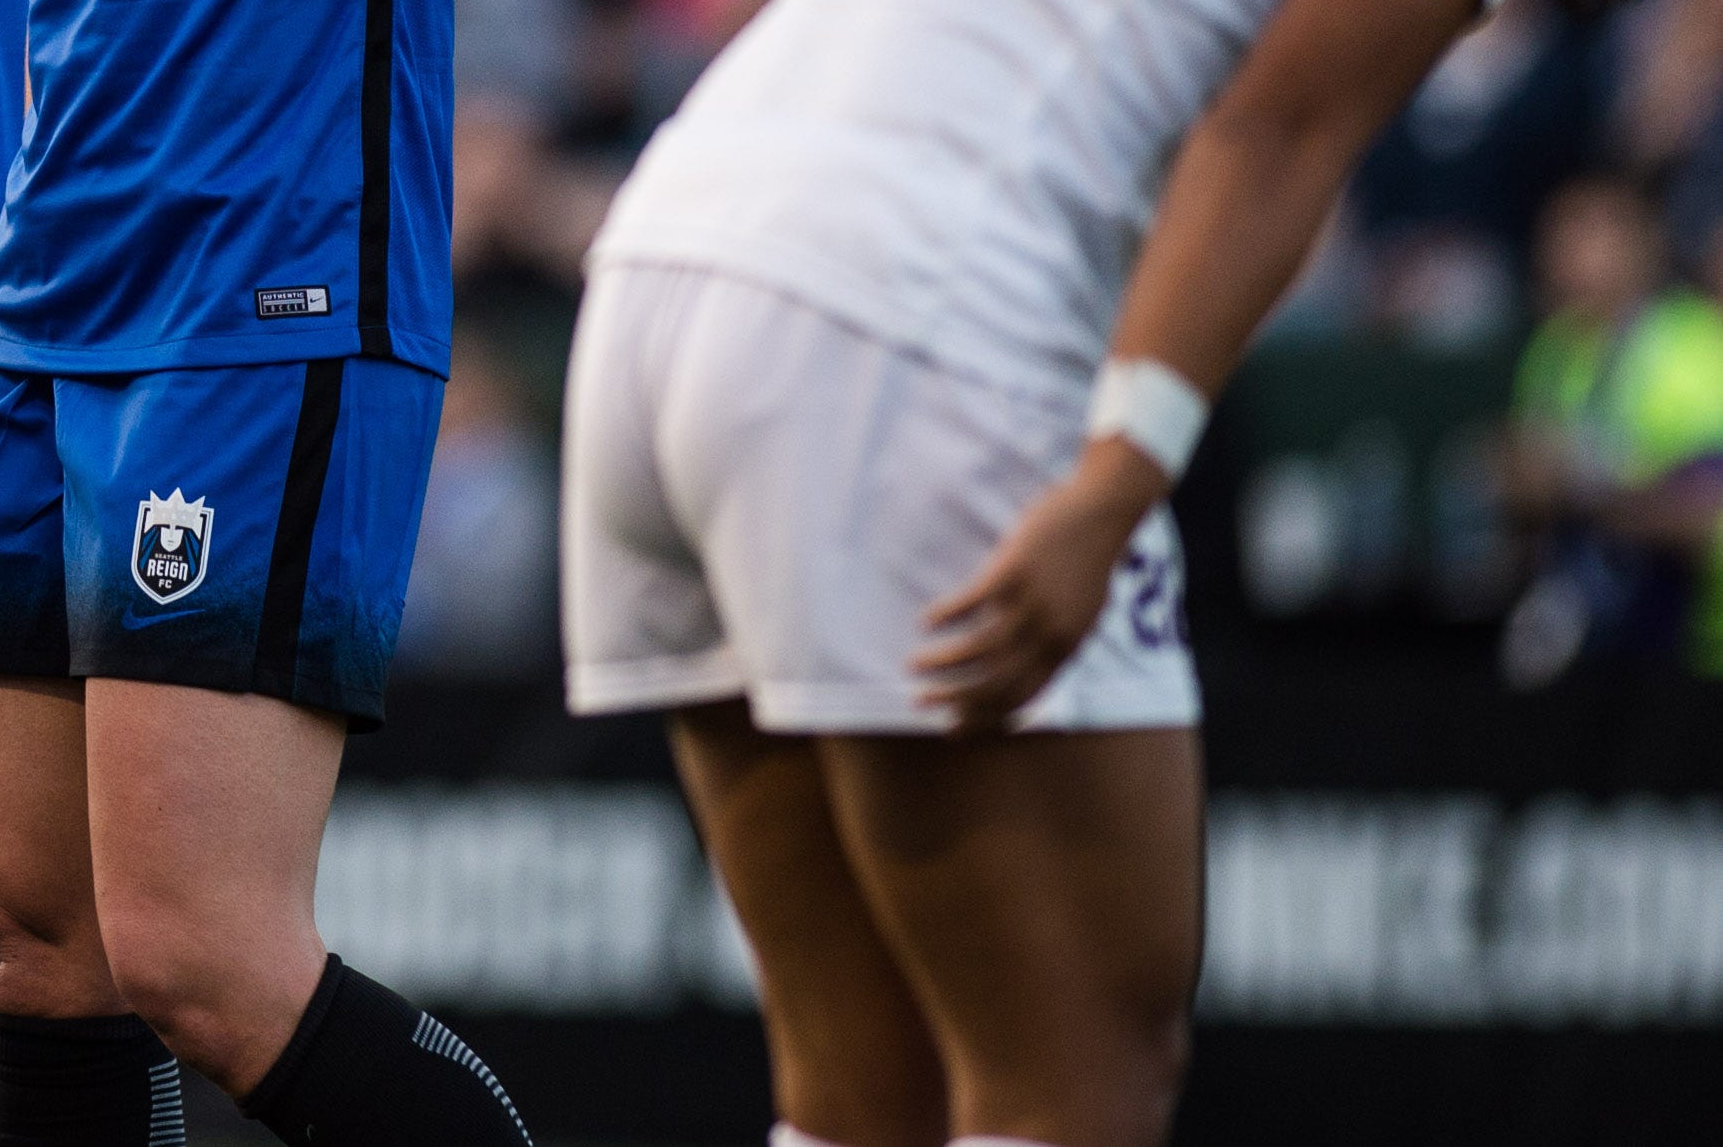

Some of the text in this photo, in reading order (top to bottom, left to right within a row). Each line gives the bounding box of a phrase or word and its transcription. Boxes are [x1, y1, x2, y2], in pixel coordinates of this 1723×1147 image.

[262, 292, 305, 300] AUTHENTIC
[155, 553, 183, 561] SEATTLE
[147, 558, 189, 582] REIGN
[158, 578, 173, 589] FC
